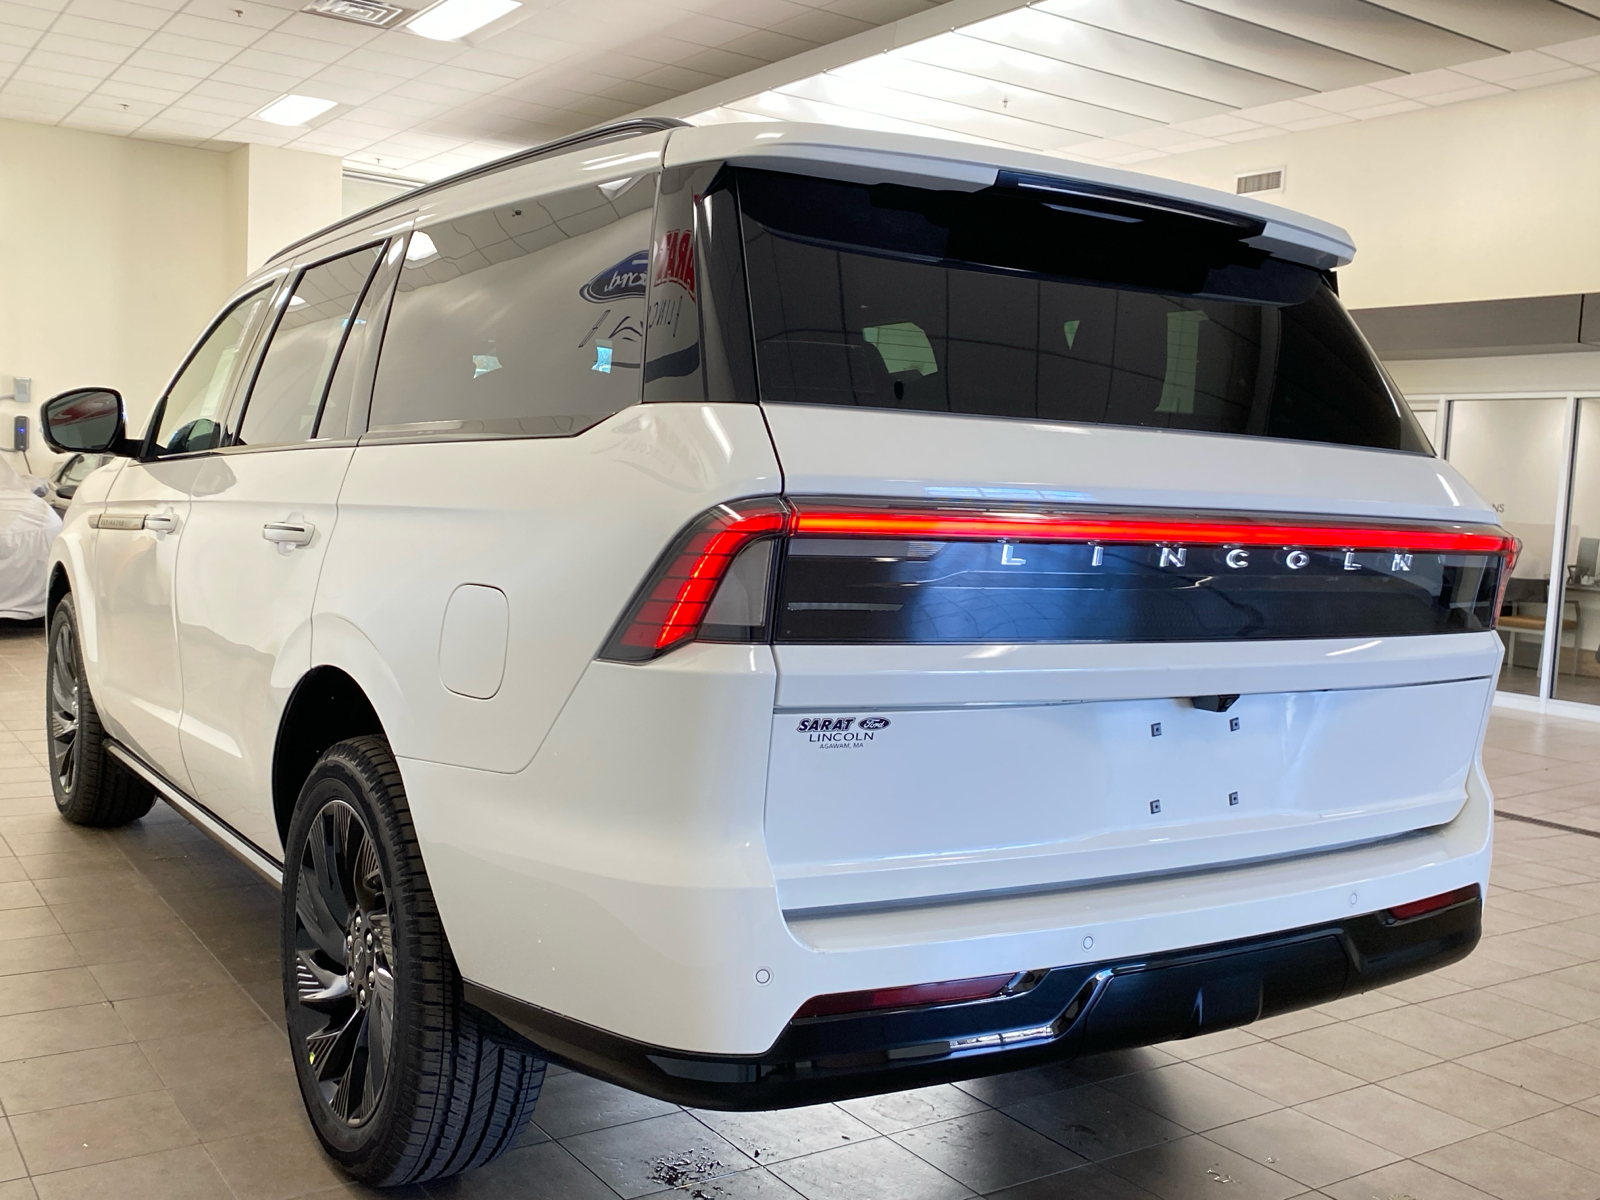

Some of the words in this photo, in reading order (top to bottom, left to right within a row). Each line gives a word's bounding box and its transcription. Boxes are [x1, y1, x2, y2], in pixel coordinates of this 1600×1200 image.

[1001, 543, 1413, 572] LINCOLN
[797, 718, 855, 732] SARAT
[809, 732, 874, 743] LINCOLN
